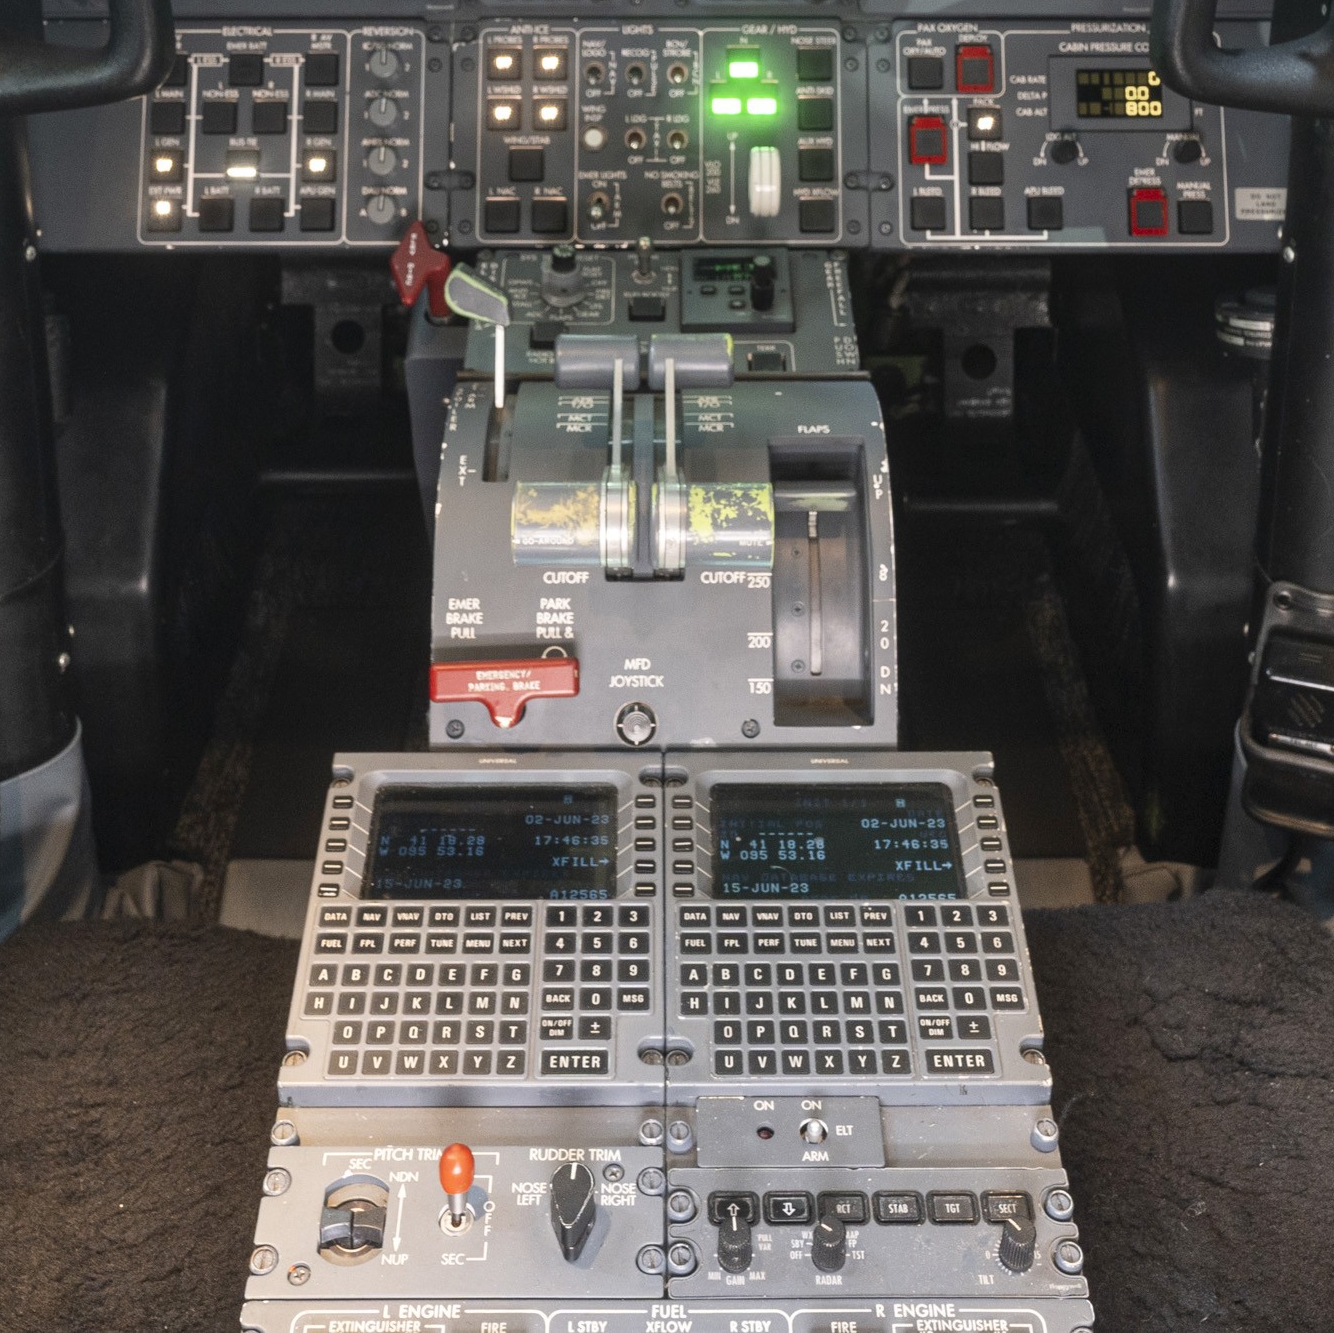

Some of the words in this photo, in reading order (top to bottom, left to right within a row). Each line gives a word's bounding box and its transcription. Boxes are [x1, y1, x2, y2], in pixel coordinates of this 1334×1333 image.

[222, 26, 272, 36] ELECTRICAL
[362, 27, 414, 36] REVERSION
[621, 25, 653, 35] LIGHTS
[917, 23, 935, 33] PAX
[938, 23, 978, 33] OXYGEN
[1070, 23, 1147, 33] PRESSURIZATION
[1059, 42, 1089, 52] CABIN
[1090, 42, 1132, 52] PRESSURE
[1125, 101, 1162, 116] 800
[797, 425, 830, 434] FLAPS
[544, 571, 589, 585] CUTOFF
[701, 571, 746, 584] CUTOFF
[747, 576, 770, 589] 250
[449, 599, 480, 610] EMER
[540, 599, 571, 610] PARK
[446, 613, 483, 625] BRAKE
[536, 613, 574, 625] BRAKE
[451, 627, 476, 639] PULL
[536, 627, 561, 639] PULL
[564, 627, 574, 639] &
[748, 636, 770, 648] 200
[624, 659, 651, 670] MFD
[476, 670, 531, 680] EMERGENCY/
[513, 681, 540, 690] BRAKE
[609, 675, 664, 688] JOYSTICK
[749, 682, 771, 694] 150
[525, 815, 609, 824] 02-JUN-23
[861, 819, 945, 828] 02-JUN-23
[535, 836, 609, 845] 17:46:35
[720, 840, 729, 849] N
[750, 840, 766, 849] 41
[779, 840, 824, 849] 18.28
[874, 840, 948, 849] 17:46:35
[720, 851, 730, 860] W
[740, 851, 768, 860] 095
[778, 851, 825, 860] 53.16
[896, 861, 941, 871] XFILL
[723, 883, 809, 893] 15-JUN-23
[684, 912, 706, 920] DATA
[723, 912, 739, 920] NAV
[757, 912, 778, 920] VNAV
[830, 911, 849, 920] LIST
[864, 912, 887, 920] PREV
[685, 939, 706, 947] FUEL
[724, 939, 740, 947] FPL
[758, 939, 780, 947] PERF
[794, 939, 817, 947] TUNE
[830, 939, 855, 947] MENU
[867, 938, 890, 947] NEXT
[919, 994, 944, 1003] BACK
[996, 994, 1017, 1002] MSG
[550, 1056, 600, 1068] ENTER
[934, 1055, 985, 1067] ENTER
[754, 1100, 774, 1110] ON
[802, 1100, 821, 1110] ON
[836, 1126, 853, 1136] ELT
[374, 1149, 411, 1161] PITCH
[529, 1149, 586, 1161] RUDDER
[589, 1149, 621, 1161] TRIM
[802, 1151, 829, 1161] ARM
[389, 1172, 418, 1182] NDN
[512, 1183, 547, 1193] NOSE
[601, 1184, 636, 1194] NOSE
[517, 1195, 541, 1205] LEFT
[601, 1195, 636, 1206] RIGHT
[837, 1204, 851, 1214] RCT
[889, 1204, 908, 1214] STAB
[945, 1204, 960, 1214] TGT
[999, 1204, 1017, 1214] SECT
[381, 1255, 408, 1265] NUP
[441, 1254, 464, 1265] SEC
[790, 1251, 803, 1260] OFF
[852, 1251, 865, 1260] TST
[726, 1276, 745, 1285] GAIN
[816, 1276, 842, 1285] RADAR
[978, 1275, 994, 1285] TILT
[383, 1307, 391, 1318] L
[400, 1305, 460, 1318] ENGINE
[651, 1304, 687, 1318] FUEL
[876, 1305, 885, 1317] R
[894, 1305, 954, 1318] ENGINE
[329, 1322, 420, 1332] EXTINGUISHER
[568, 1322, 573, 1332] L
[578, 1322, 607, 1332] STBY
[646, 1321, 692, 1333] XFLOW
[730, 1321, 737, 1332] R
[741, 1321, 770, 1332] STBY
[917, 1321, 1008, 1330] EXTINGUISHER
